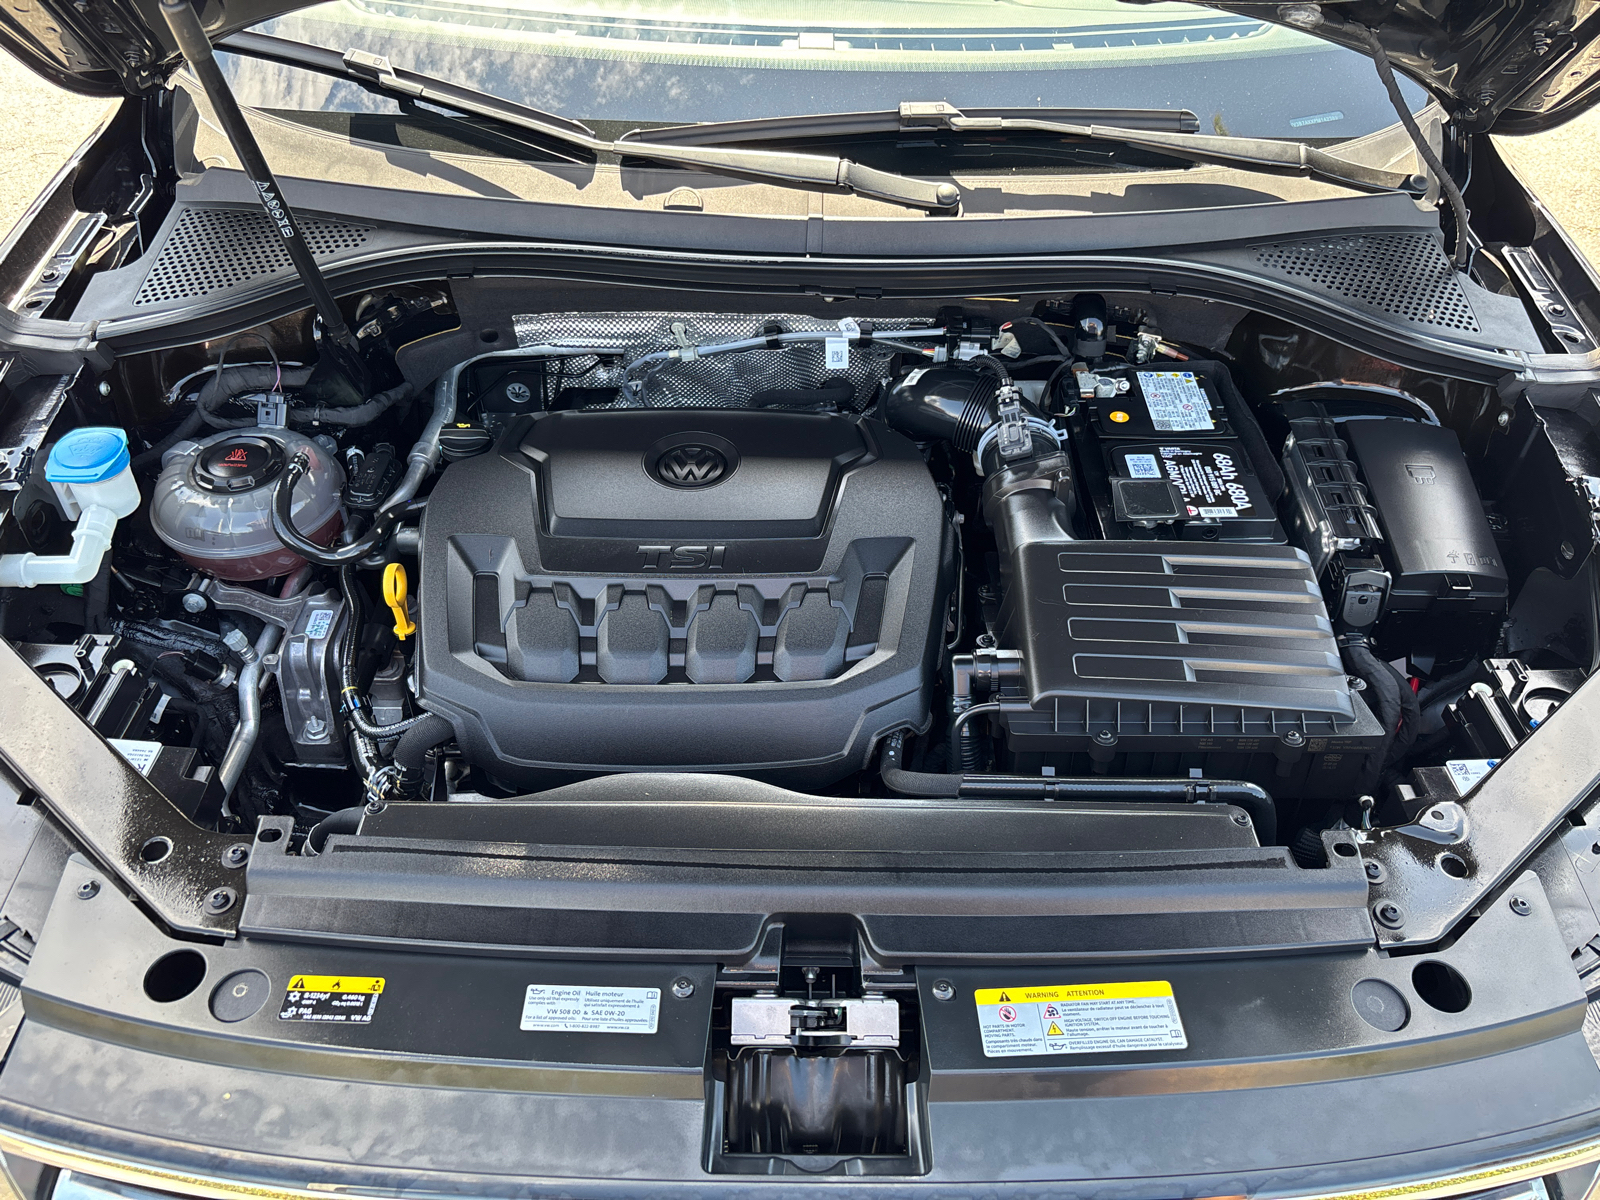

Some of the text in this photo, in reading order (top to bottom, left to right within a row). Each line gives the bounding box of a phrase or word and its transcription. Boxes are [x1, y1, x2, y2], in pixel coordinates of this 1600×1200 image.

[659, 445, 725, 484] VW
[1212, 453, 1252, 510] 68Ah 680A
[636, 545, 726, 569] TSI
[1025, 989, 1104, 999] WARNING ATTENTION
